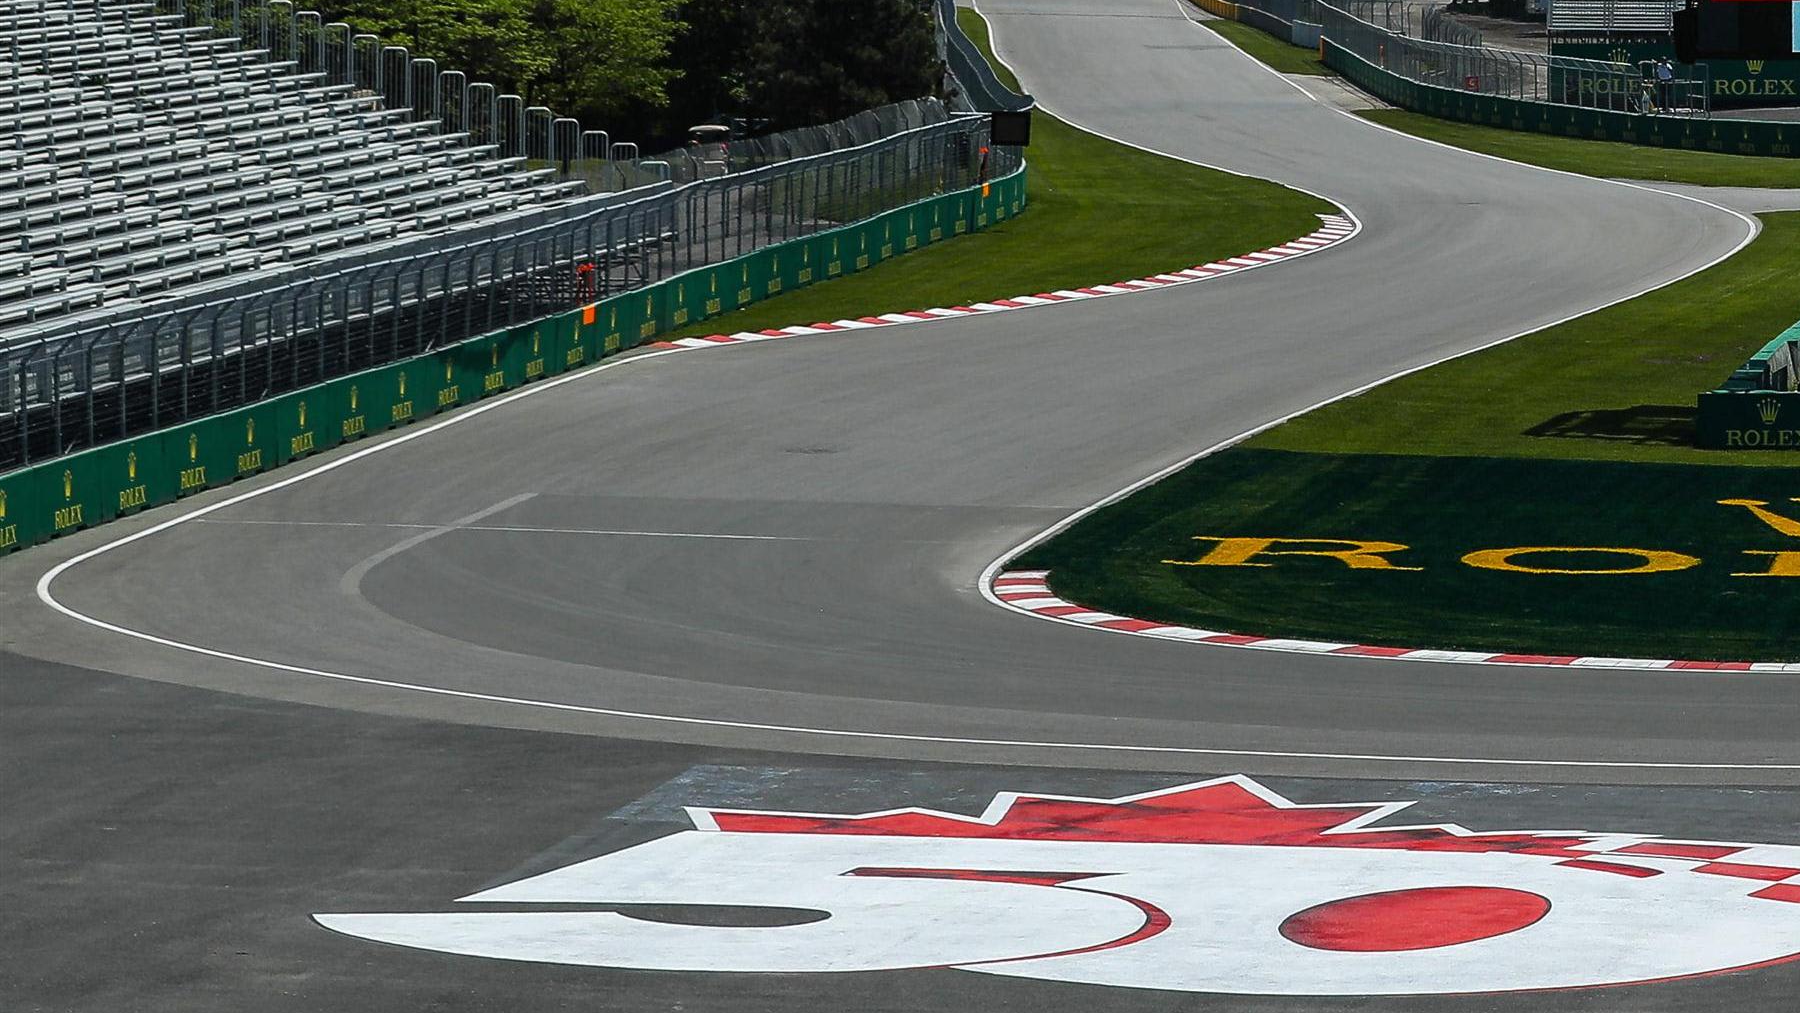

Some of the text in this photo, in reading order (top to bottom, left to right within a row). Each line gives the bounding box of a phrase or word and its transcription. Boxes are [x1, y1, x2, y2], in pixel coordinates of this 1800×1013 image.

[1713, 79, 1797, 96] ROLEX
[119, 485, 146, 510] ROLEX
[55, 504, 82, 530] ROLEX
